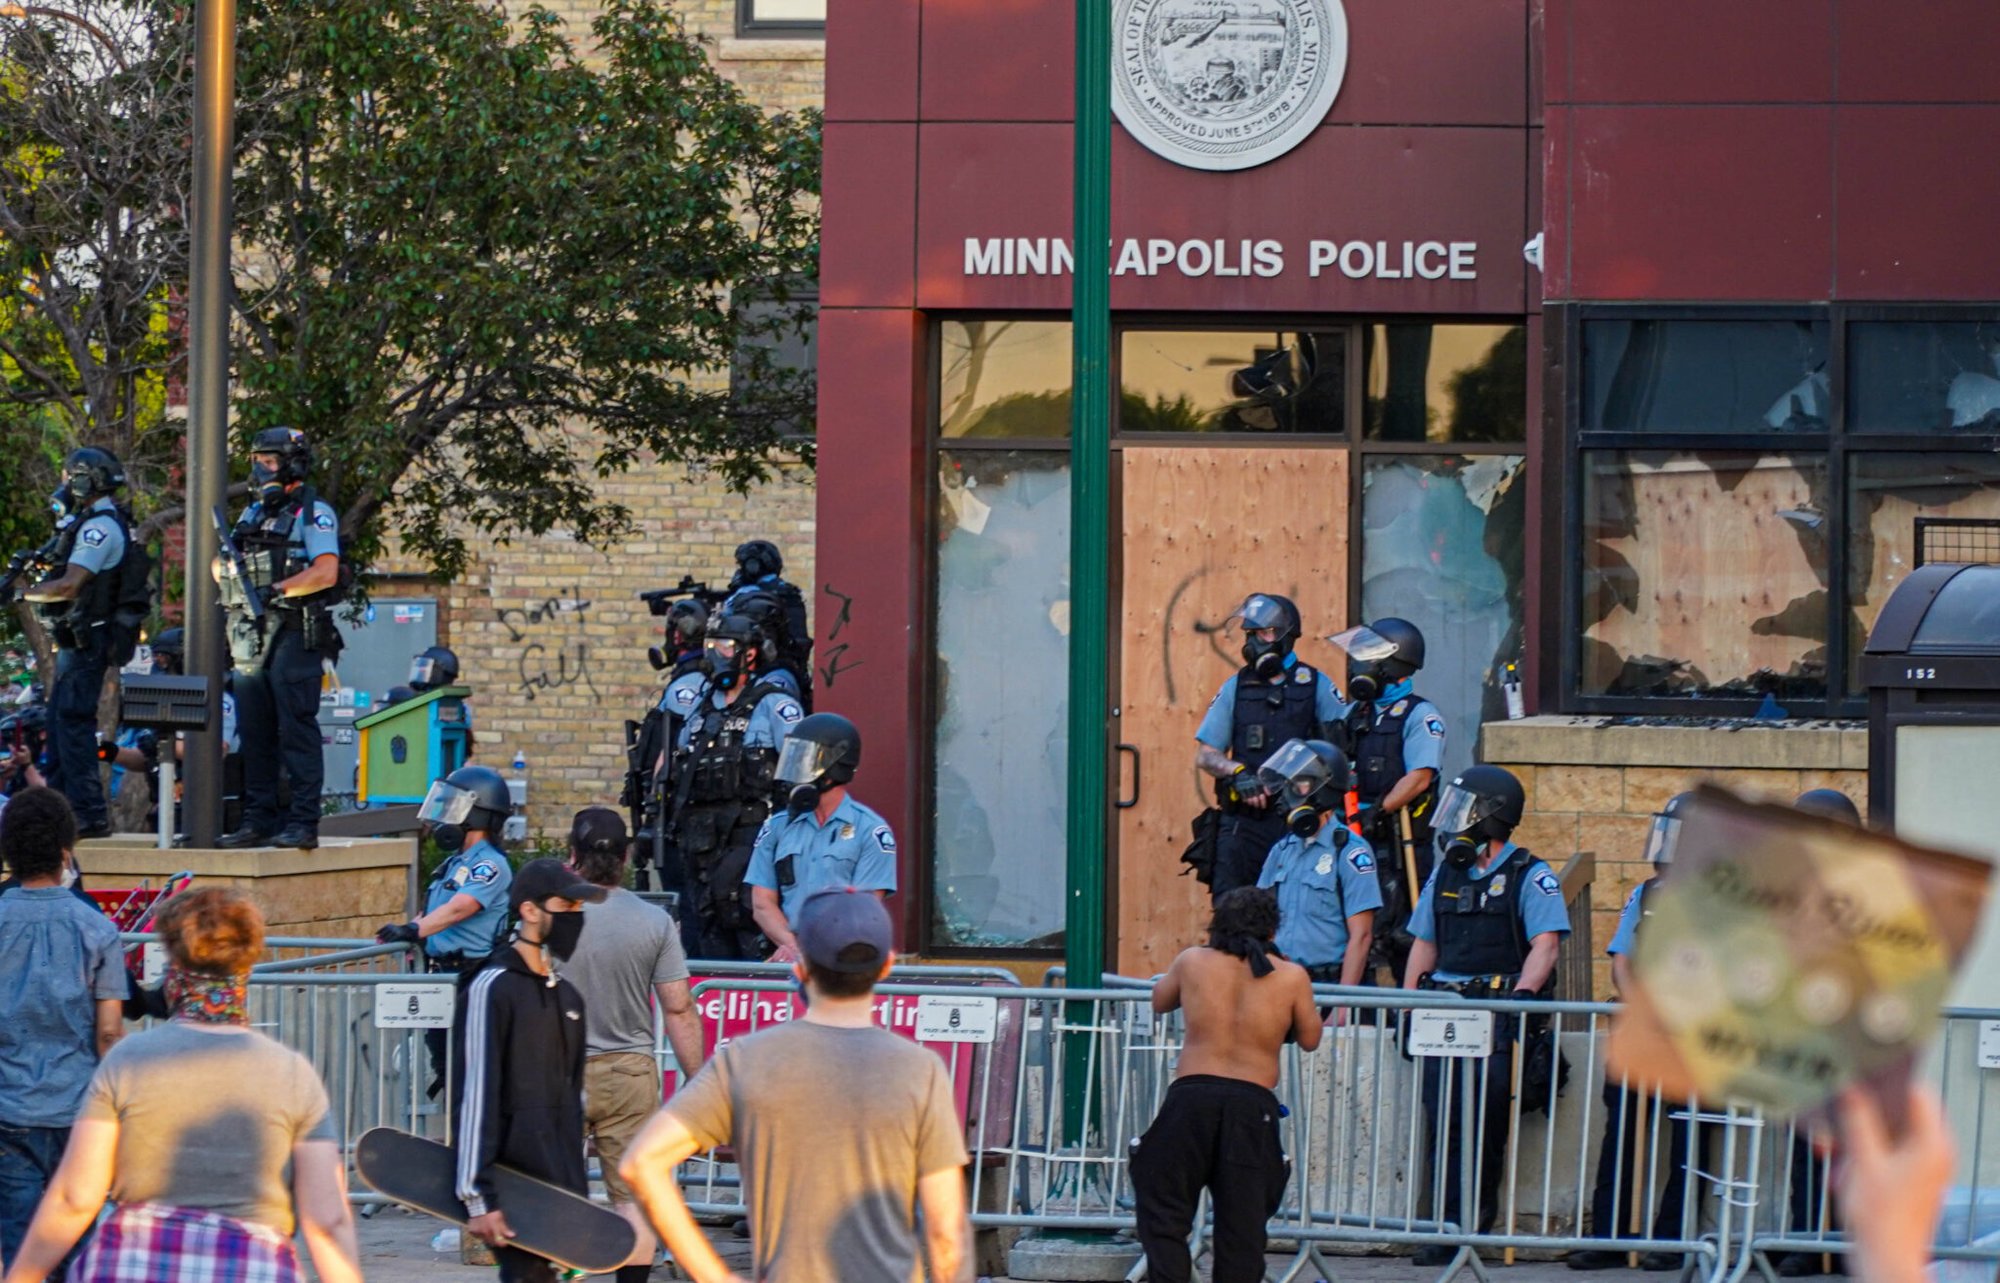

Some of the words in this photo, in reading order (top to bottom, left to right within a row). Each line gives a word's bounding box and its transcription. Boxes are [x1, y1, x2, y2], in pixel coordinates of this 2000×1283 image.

[1126, 16, 1141, 40] OF
[1126, 42, 1147, 86] SEAL
[1147, 96, 1206, 137] APPROVED
[1208, 127, 1242, 139] JUNE
[1263, 101, 1291, 126] 1878
[964, 237, 1284, 277] MINNAPOLIS
[1309, 240, 1477, 279] POLICE
[1906, 668, 1936, 679] 152
